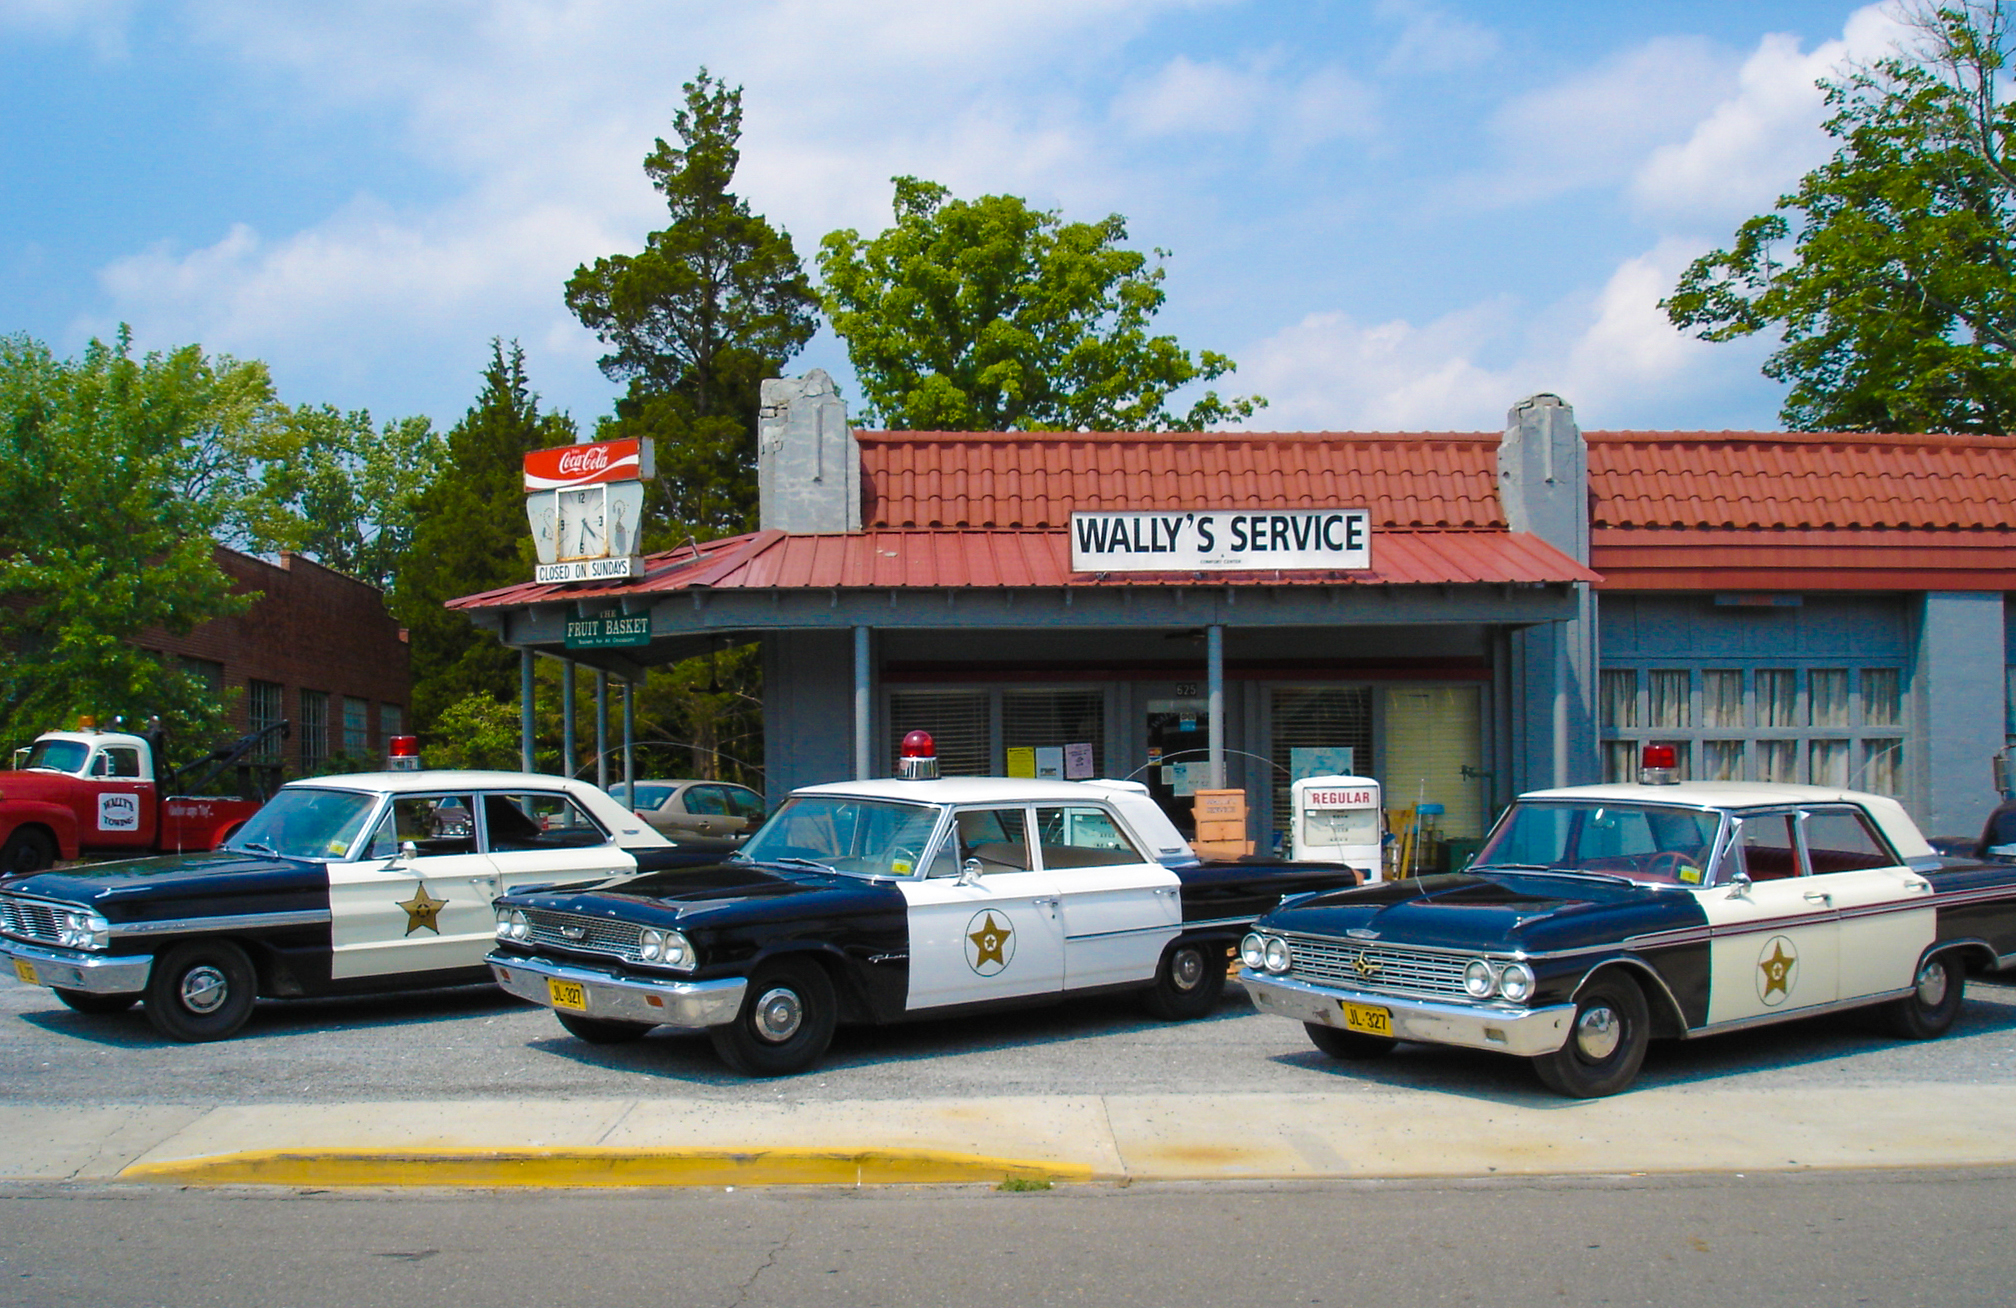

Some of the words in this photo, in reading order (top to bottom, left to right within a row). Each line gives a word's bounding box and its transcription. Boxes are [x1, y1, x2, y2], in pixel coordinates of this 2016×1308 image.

[559, 446, 609, 474] Coca-Cola
[577, 493, 586, 504] 12
[559, 519, 565, 531] 9
[598, 516, 603, 526] 3
[1076, 513, 1215, 554] WALLY'S
[1230, 515, 1363, 552] SERVICE
[539, 566, 570, 581] CLOSED
[575, 563, 587, 578] ON
[592, 560, 628, 576] SUNDAYS
[567, 621, 599, 637] FRUIT
[605, 618, 648, 635] BASKET
[1176, 684, 1197, 695] 625
[1312, 792, 1370, 804] REGULAR
[103, 815, 134, 827] TOWING
